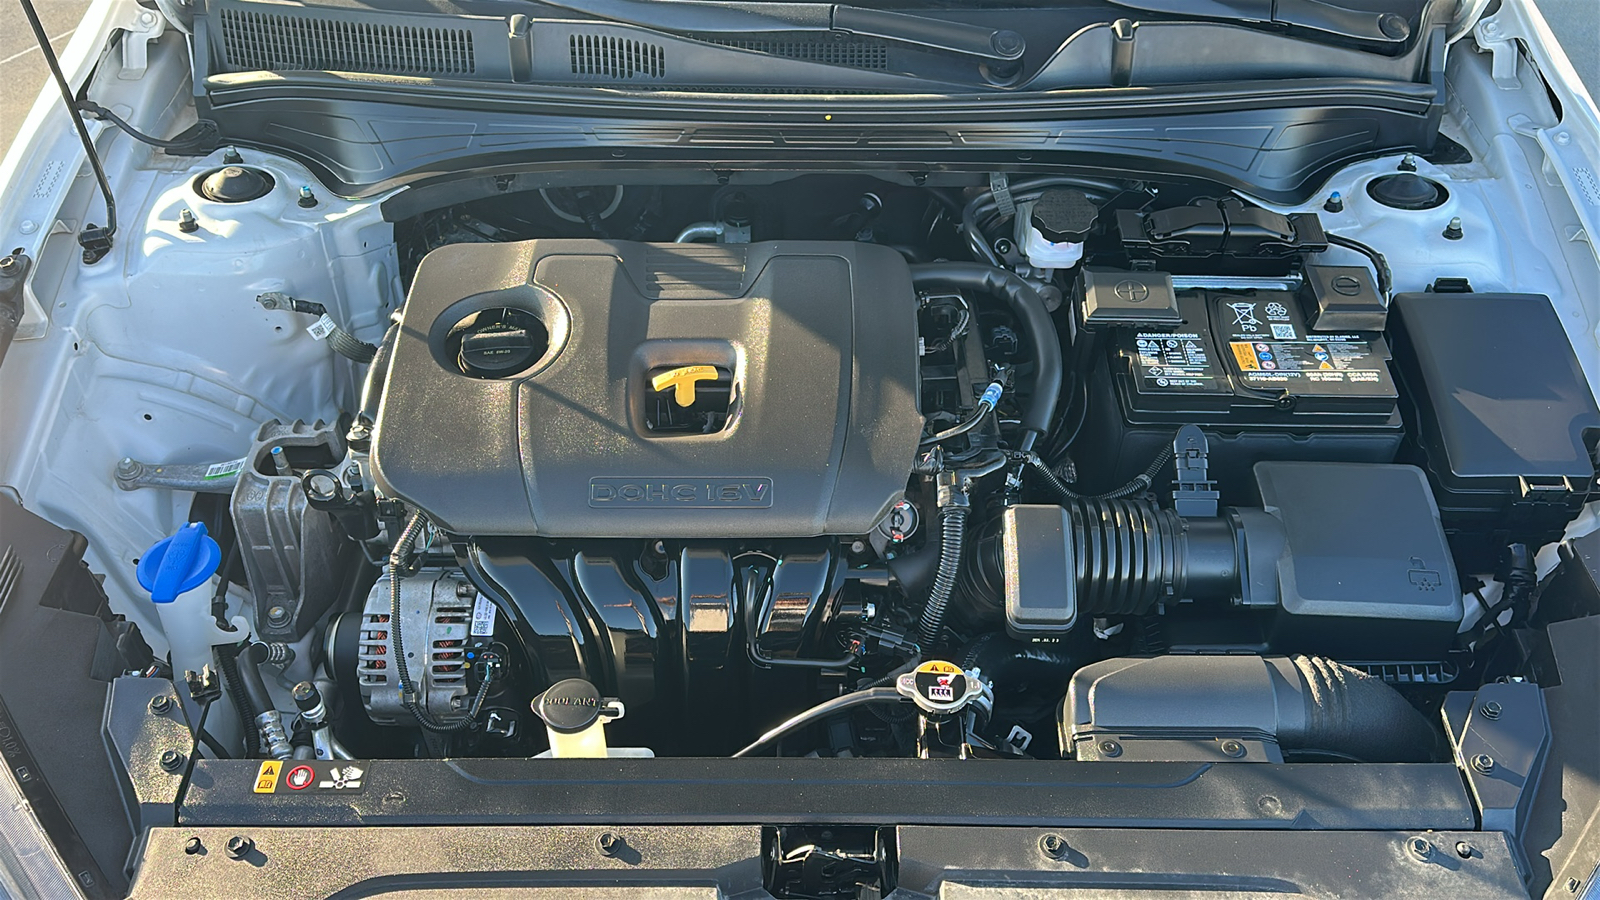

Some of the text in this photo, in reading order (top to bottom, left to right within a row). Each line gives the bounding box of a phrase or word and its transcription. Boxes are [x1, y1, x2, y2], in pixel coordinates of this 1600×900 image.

[477, 324, 506, 333] OWNER'S
[1241, 324, 1257, 332] Pb
[591, 484, 768, 501] DOHC 16V
[545, 698, 598, 706] COOLANT
